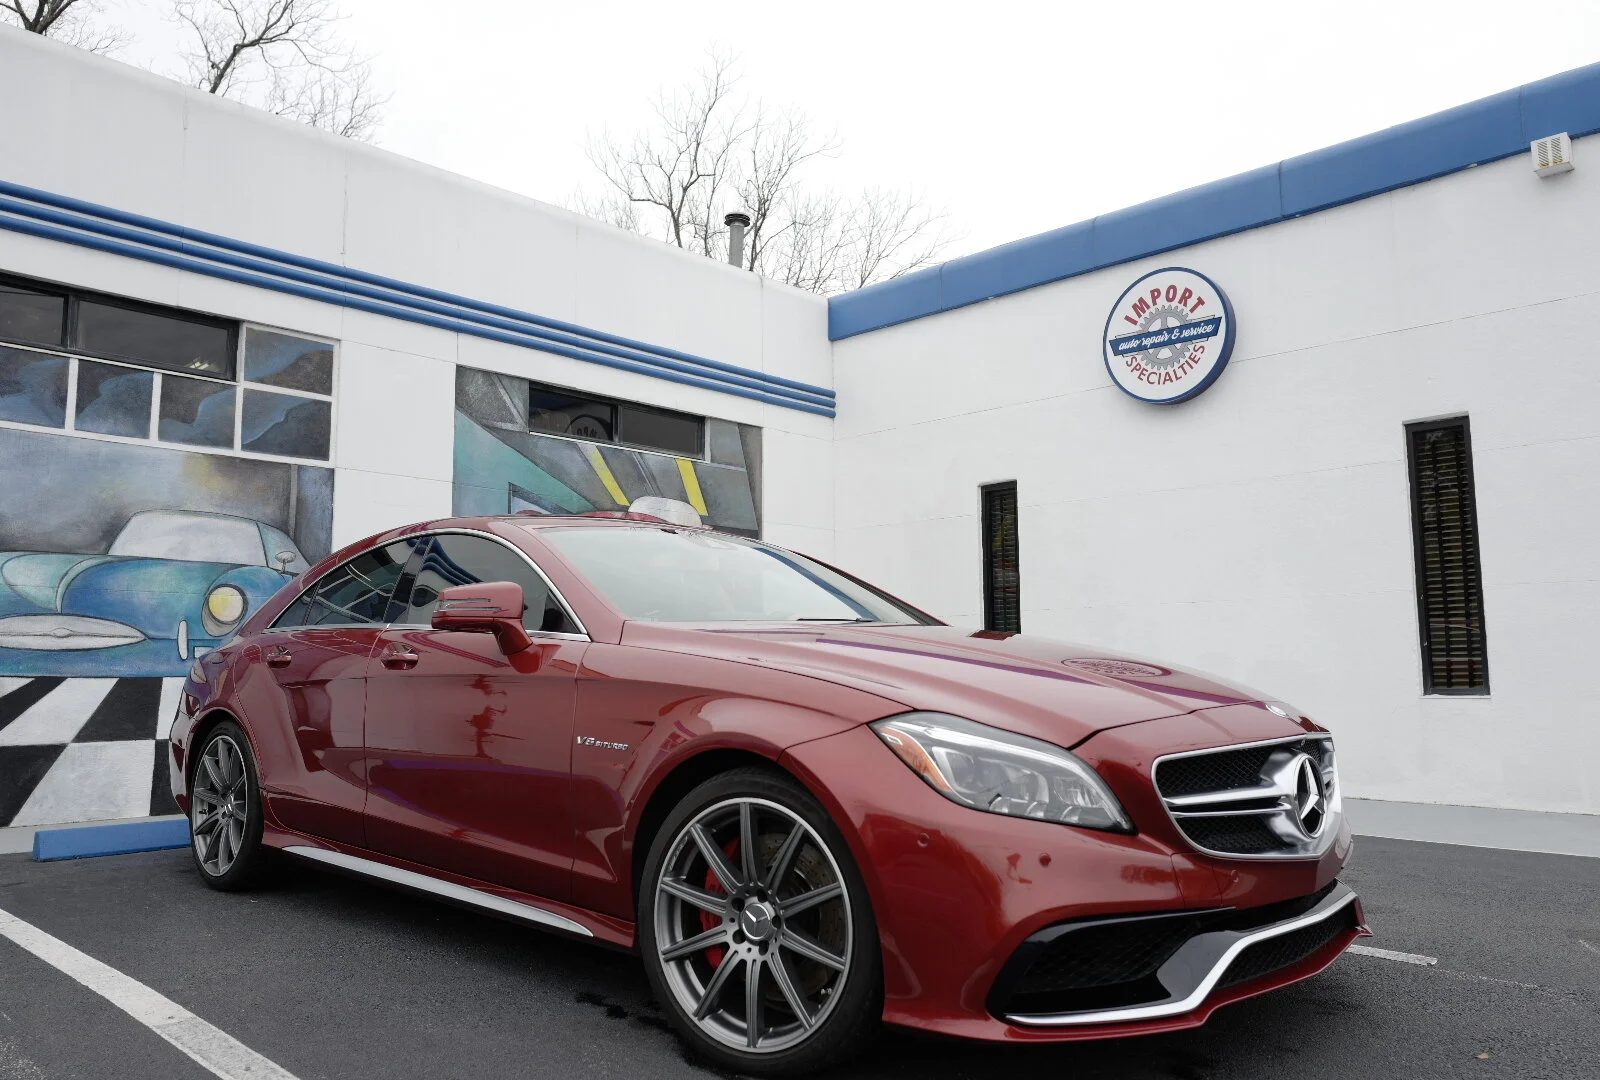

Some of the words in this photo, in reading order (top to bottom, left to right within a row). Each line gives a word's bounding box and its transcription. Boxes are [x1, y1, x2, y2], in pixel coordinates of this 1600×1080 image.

[1124, 285, 1206, 326] IMPORT
[1118, 338, 1141, 351] auto
[1141, 331, 1170, 348] repair
[1171, 329, 1181, 340] &
[1180, 323, 1216, 339] service
[1125, 344, 1205, 385] SPECIALTIES
[595, 740, 629, 751] BITURBO
